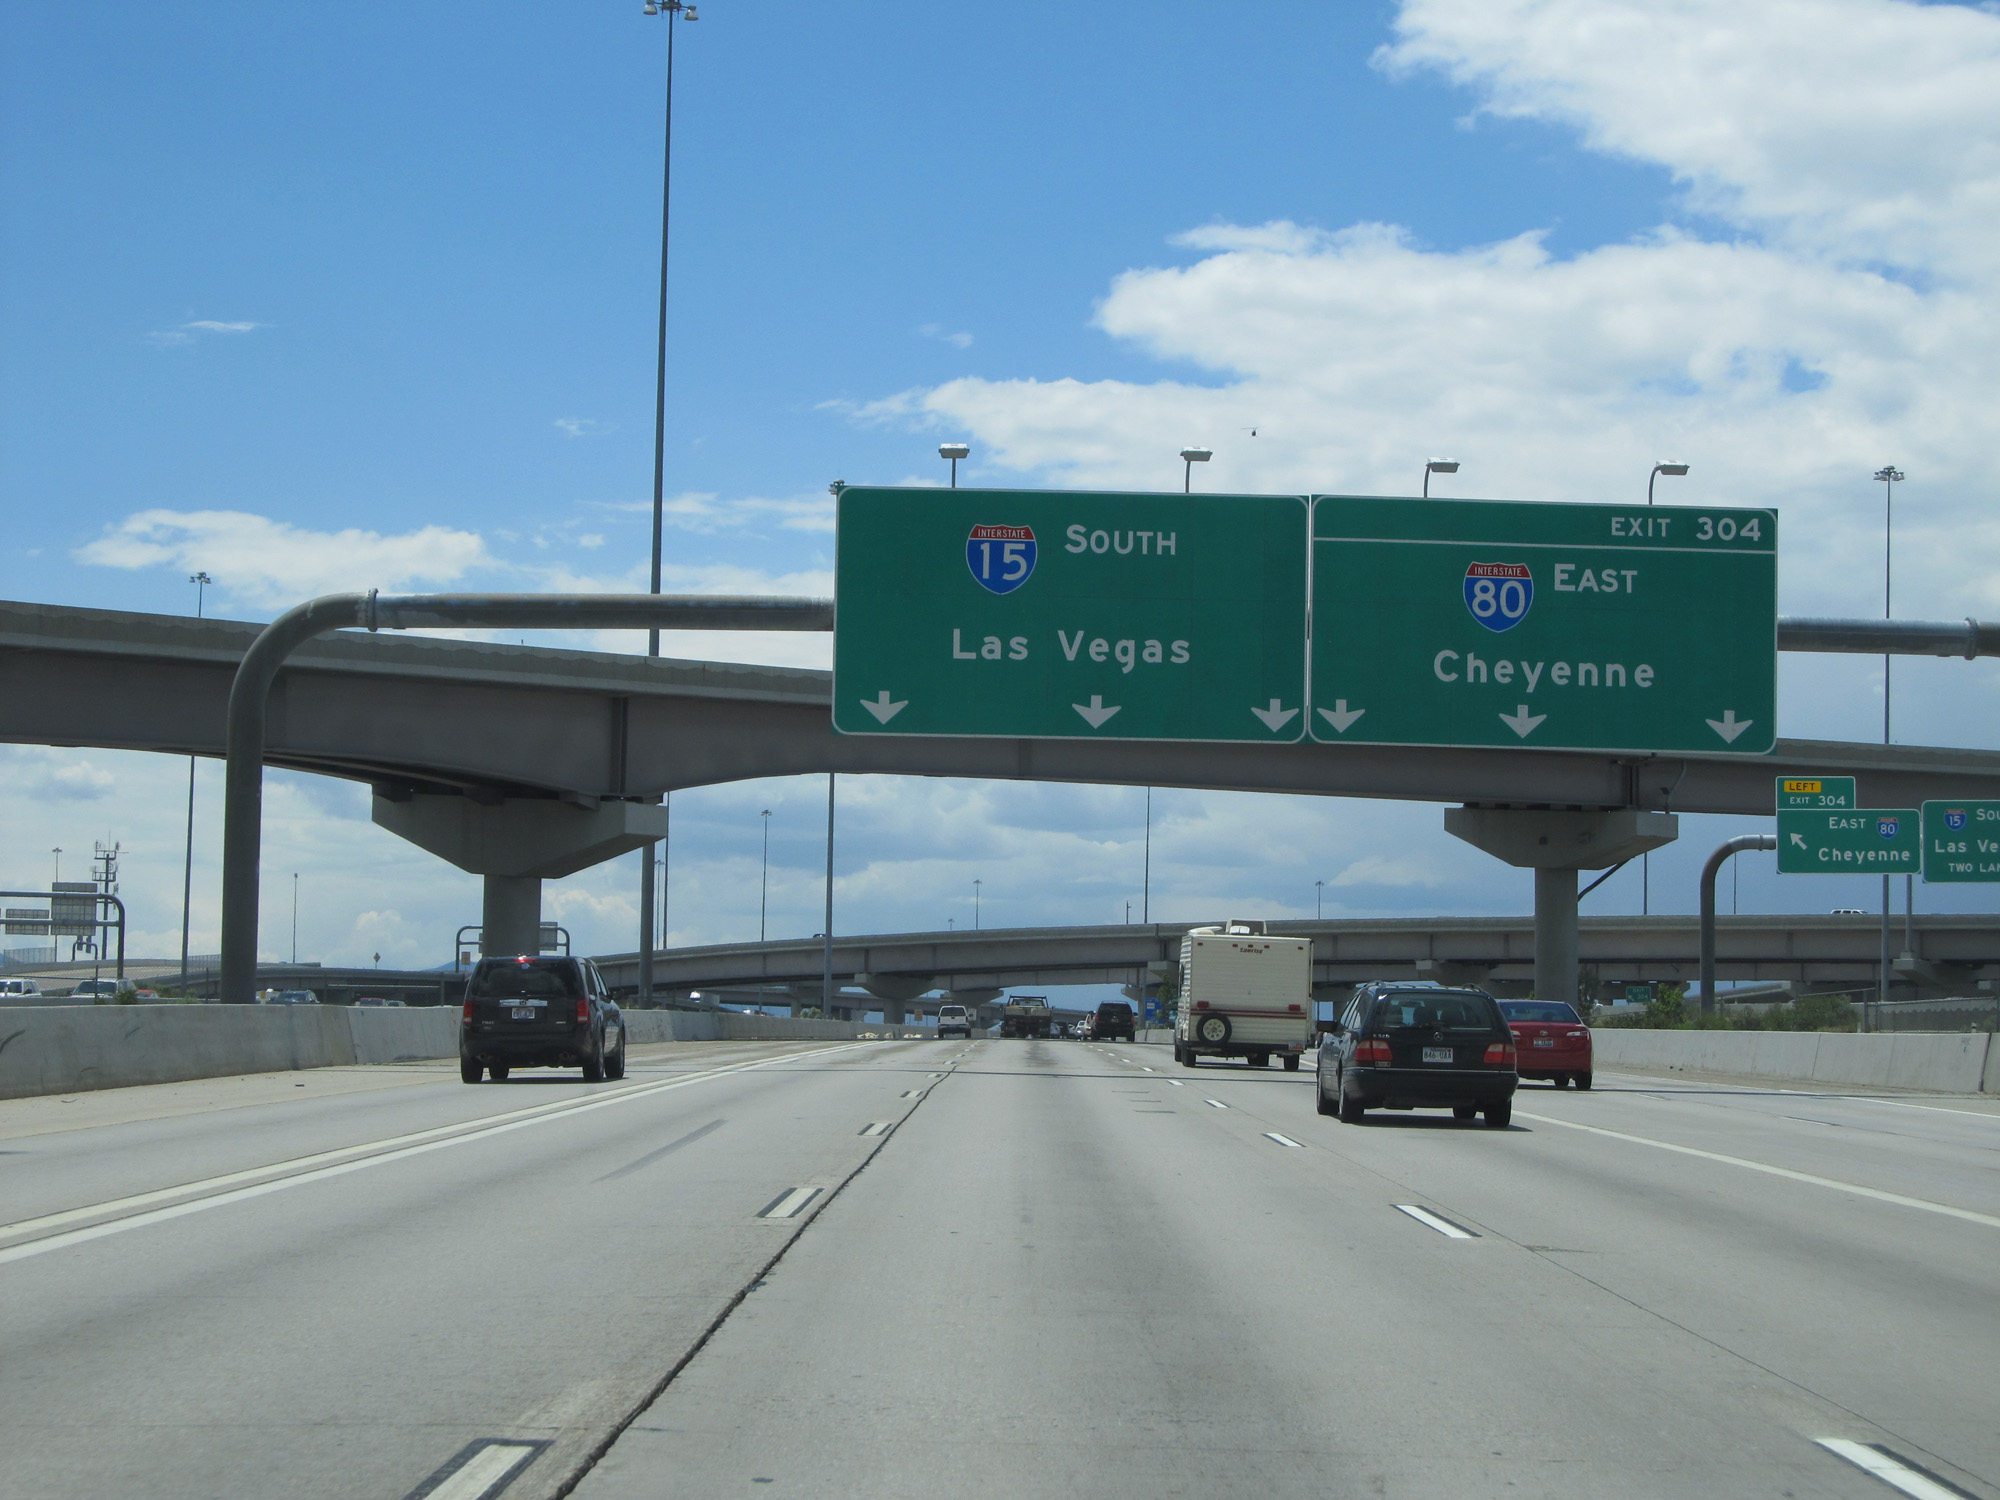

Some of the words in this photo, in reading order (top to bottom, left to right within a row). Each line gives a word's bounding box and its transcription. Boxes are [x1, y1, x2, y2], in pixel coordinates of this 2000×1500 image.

[977, 528, 1026, 539] INTERSTATE
[1611, 516, 1671, 537] EXIT
[1695, 516, 1761, 542] 304
[1064, 524, 1176, 556] SOUTH
[980, 542, 1028, 581] 15
[1474, 566, 1522, 577] INTERSTATE
[1554, 563, 1638, 594] EAST
[1471, 579, 1526, 618] 80
[952, 628, 1029, 661] Las
[1057, 629, 1190, 674] Vegas
[1433, 649, 1655, 693] Cheyenne
[1789, 782, 1816, 791] LEFT
[1789, 796, 1810, 805] EXIT
[1818, 795, 1846, 806] 304
[1828, 816, 1866, 829] EAST
[1949, 815, 1961, 827] 15
[1880, 823, 1895, 835] 80
[1935, 839, 1967, 853] Las
[1818, 847, 1911, 865] Cheyenne
[1948, 863, 1973, 873] TWO
